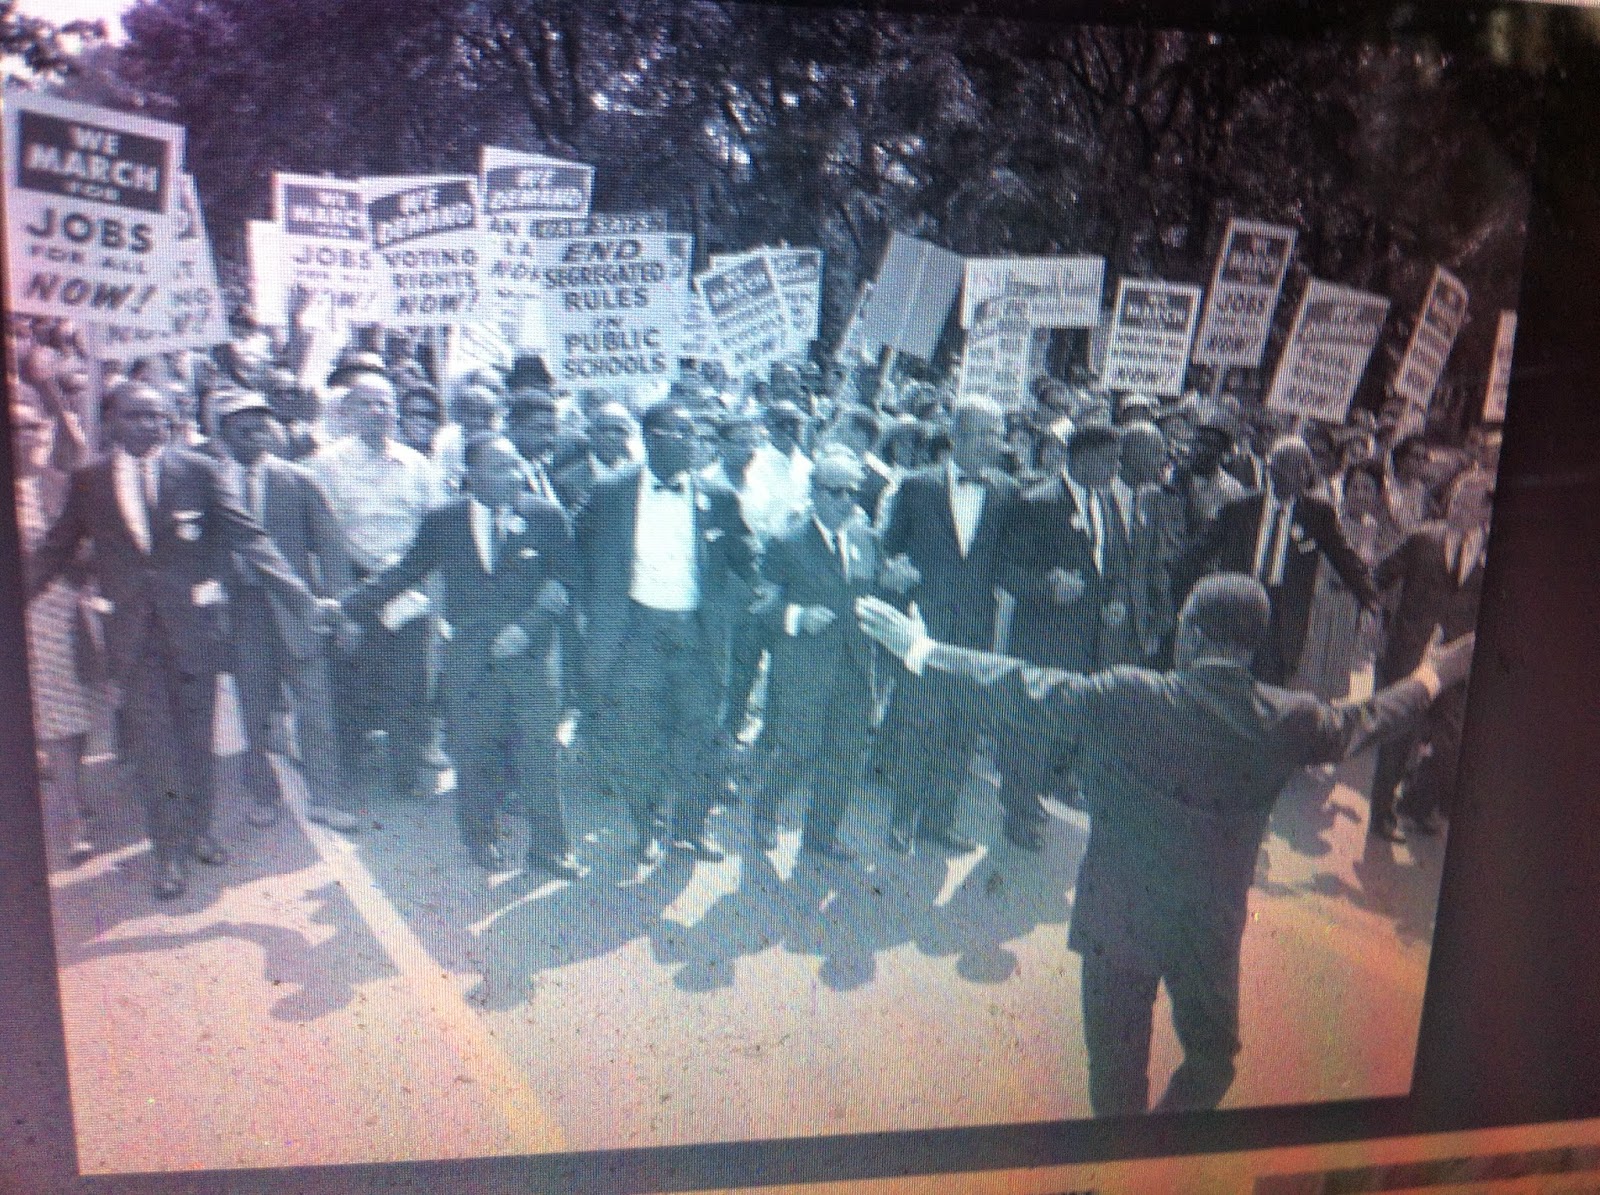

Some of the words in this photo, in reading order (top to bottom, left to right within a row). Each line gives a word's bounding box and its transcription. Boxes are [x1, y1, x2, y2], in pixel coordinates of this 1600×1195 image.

[72, 127, 119, 155] WE
[27, 143, 157, 192] MARCH
[66, 181, 118, 201] FOR
[401, 190, 437, 212] WE
[491, 189, 581, 207] DEMAND
[26, 209, 153, 253] JOBS
[379, 203, 472, 243] DEMAND
[29, 245, 83, 264] FOR
[102, 257, 147, 274] ALL
[293, 246, 371, 268] JOBS
[384, 250, 477, 267] VOTING
[563, 240, 641, 262] END
[393, 272, 476, 288] RIGHTS
[543, 262, 664, 289] SEGREGATED
[25, 273, 157, 314] NOW!
[397, 290, 478, 315] NOW!
[564, 287, 648, 311] RULES
[565, 328, 659, 353] PUBLIC
[563, 354, 665, 378] SCHOOLS
